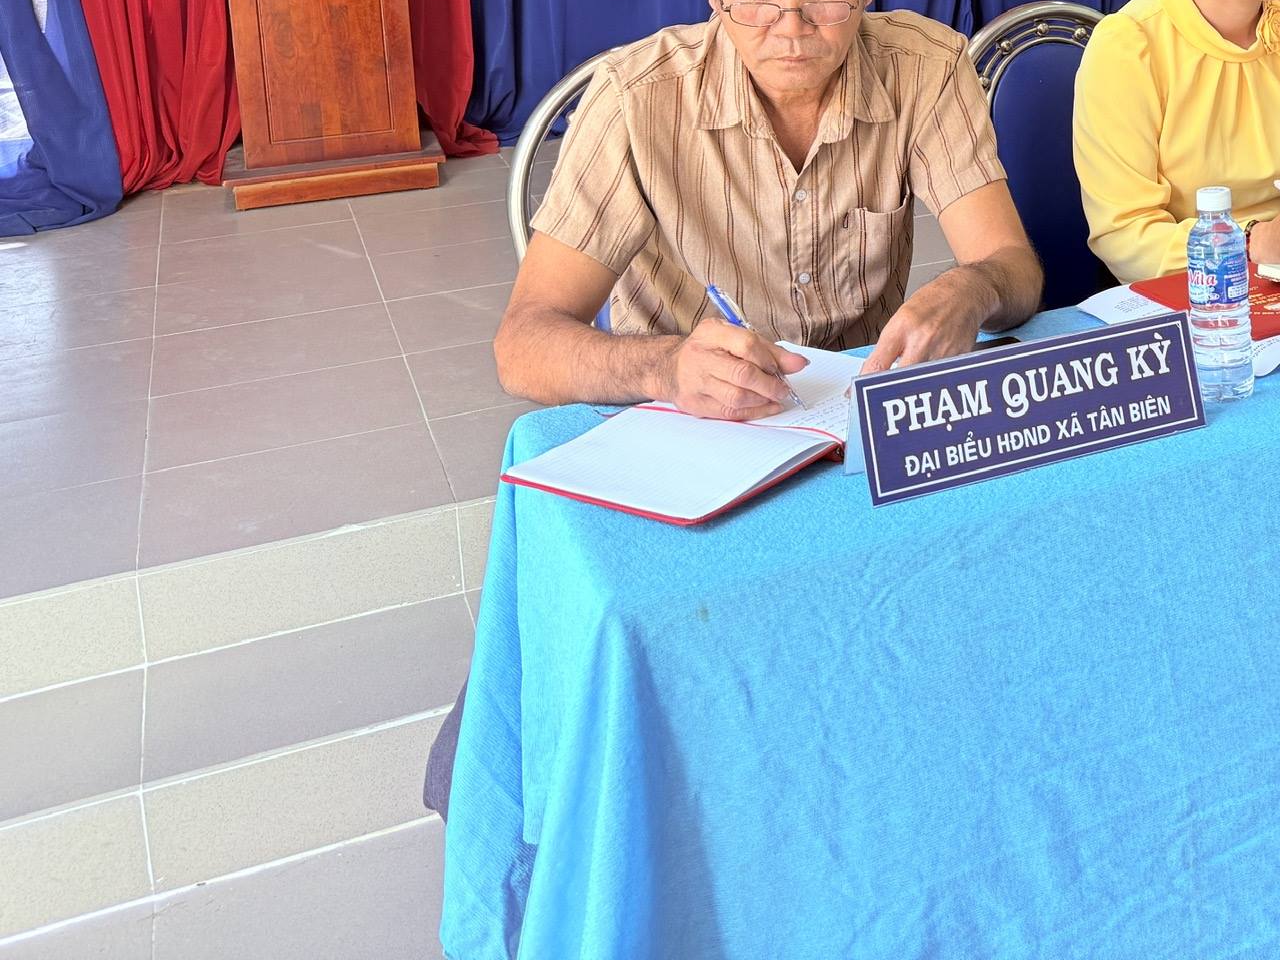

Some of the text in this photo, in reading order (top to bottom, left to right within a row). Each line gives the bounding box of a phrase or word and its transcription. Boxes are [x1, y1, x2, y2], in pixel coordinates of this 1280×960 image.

[882, 379, 992, 437] PHẠM
[1001, 352, 1119, 419] QUANG
[1126, 332, 1172, 381] KỲ
[904, 394, 1172, 478] ĐẠI BIỂU HĐND XÃ TÂN BIÊN
